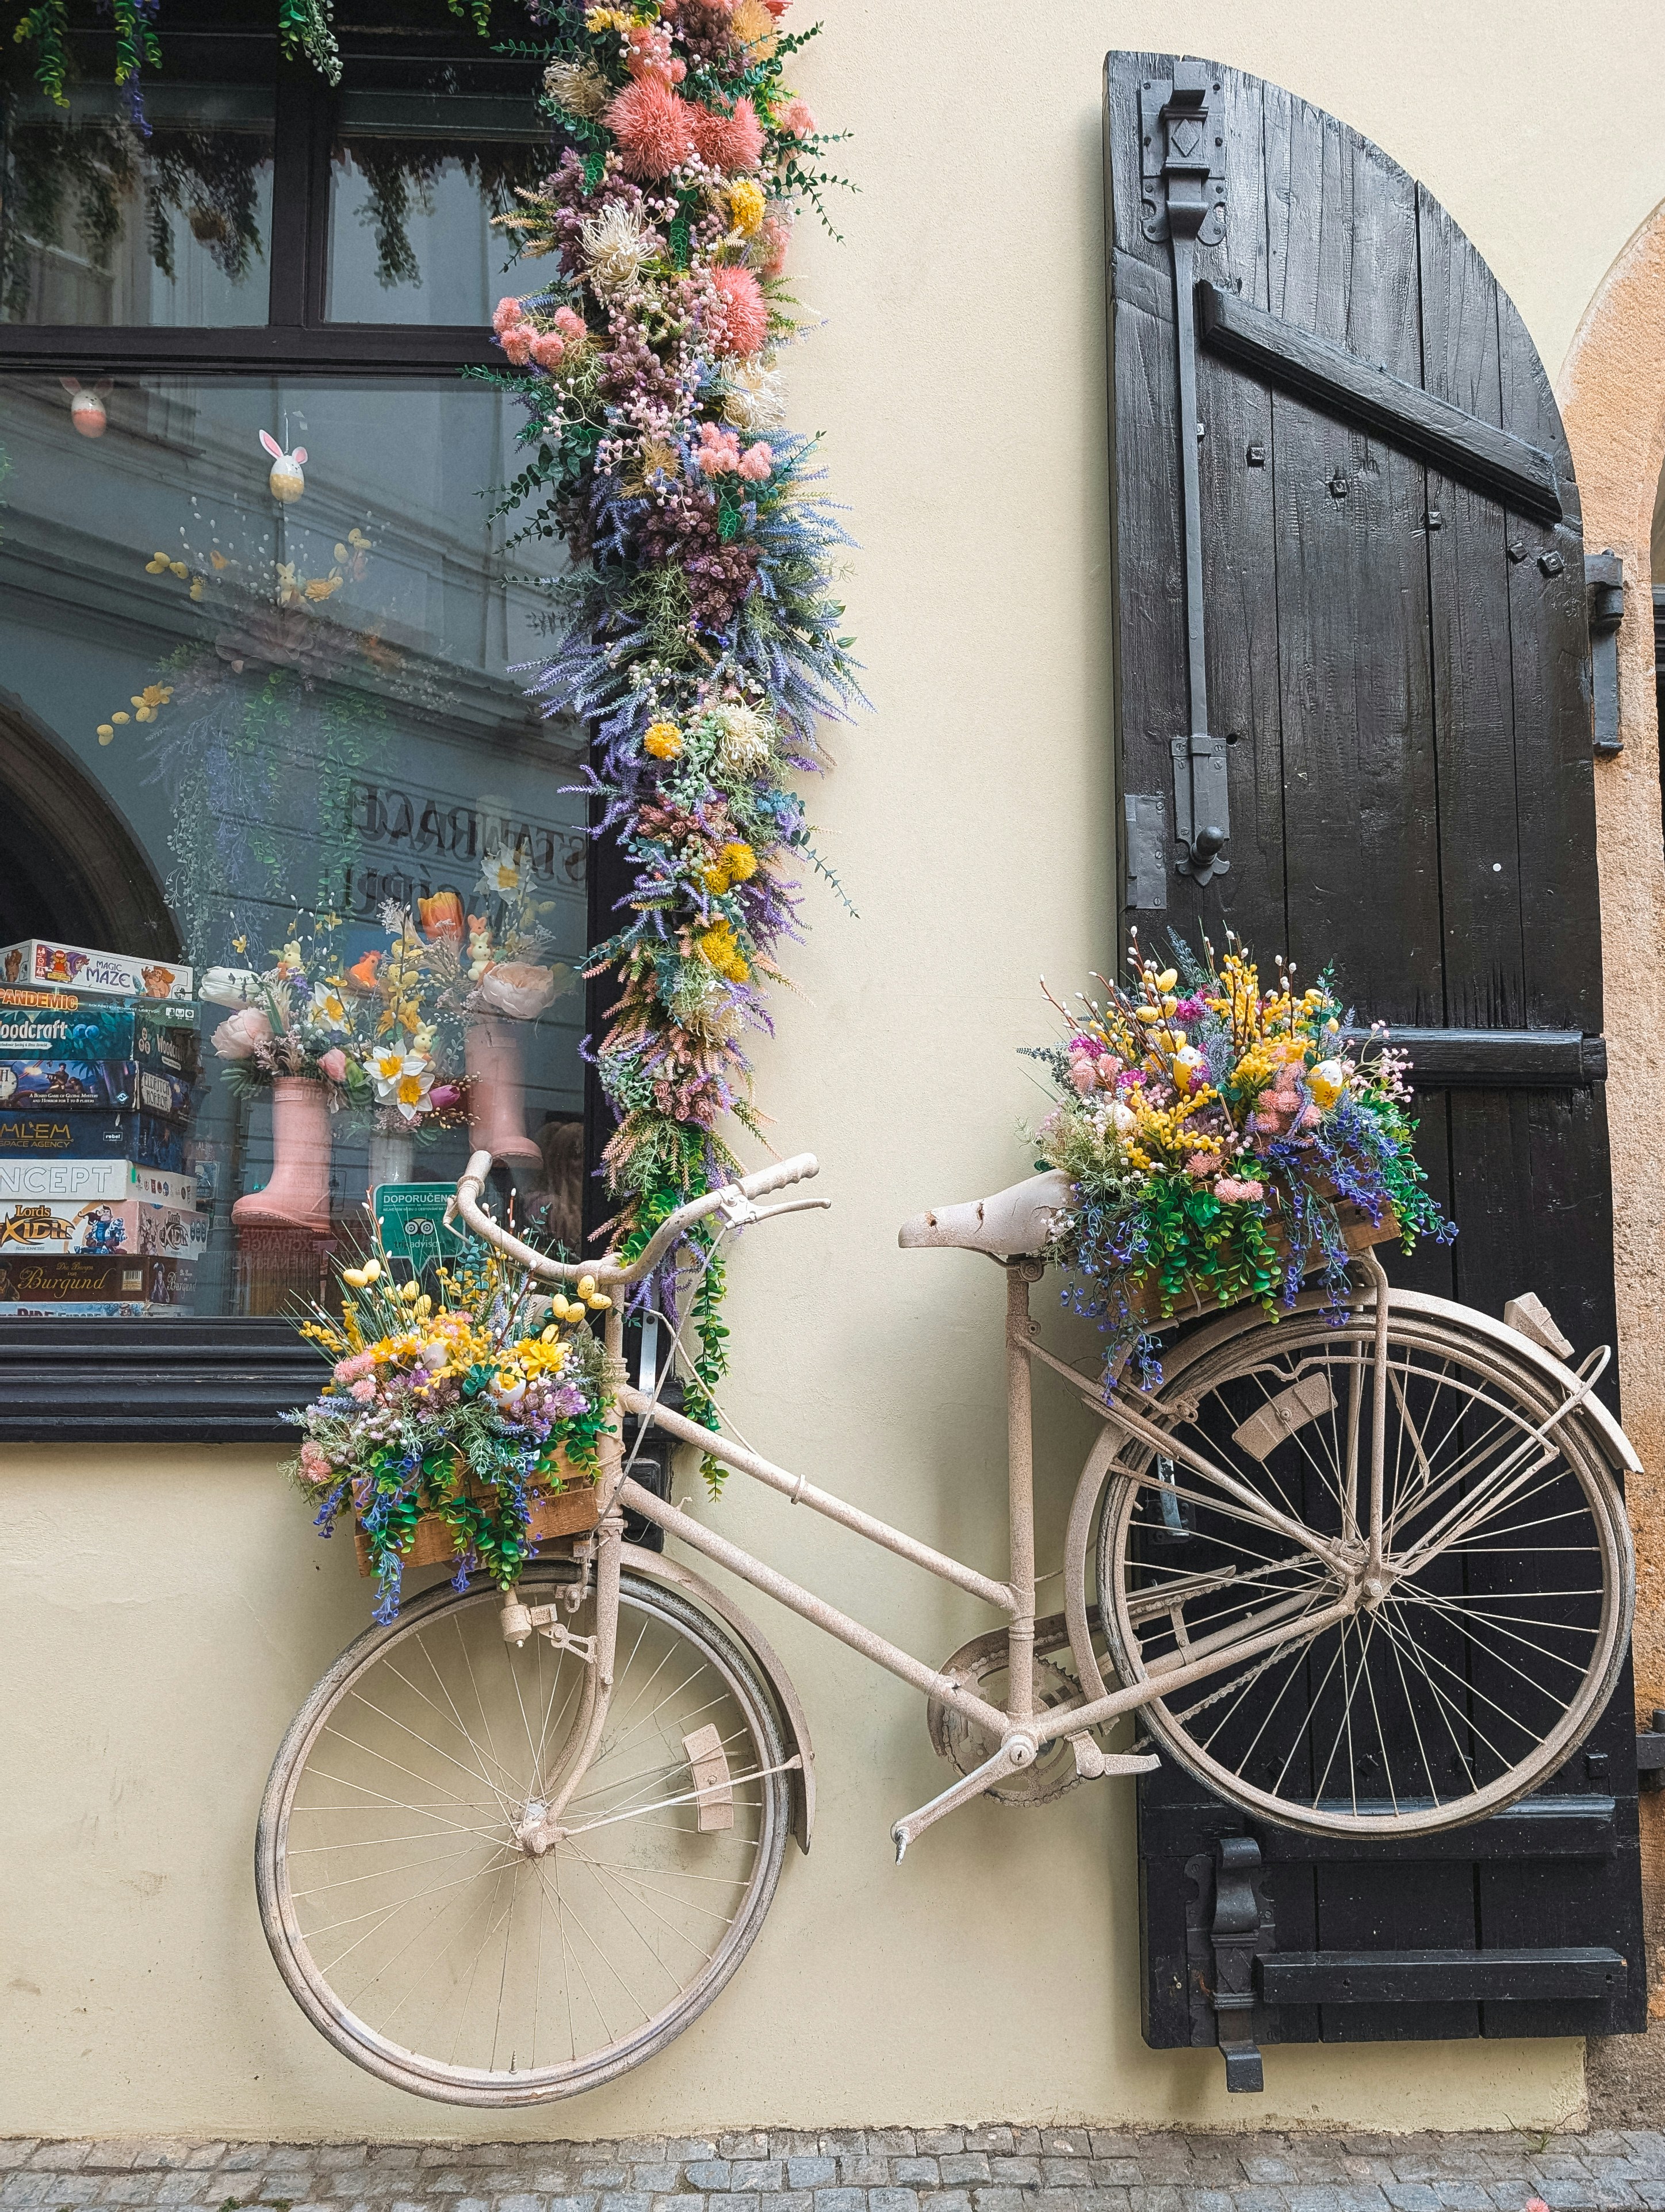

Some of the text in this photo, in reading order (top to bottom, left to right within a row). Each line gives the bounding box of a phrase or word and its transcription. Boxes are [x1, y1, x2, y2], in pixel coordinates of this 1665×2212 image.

[97, 960, 122, 971] MAGIC
[86, 967, 130, 988] MAZE
[144, 1074, 170, 1096] ELDRITCH
[146, 1089, 169, 1111] HORROR
[16, 1205, 51, 1218] Lords
[18, 1266, 116, 1299] Burgund
[167, 1271, 197, 1299] Burgund
